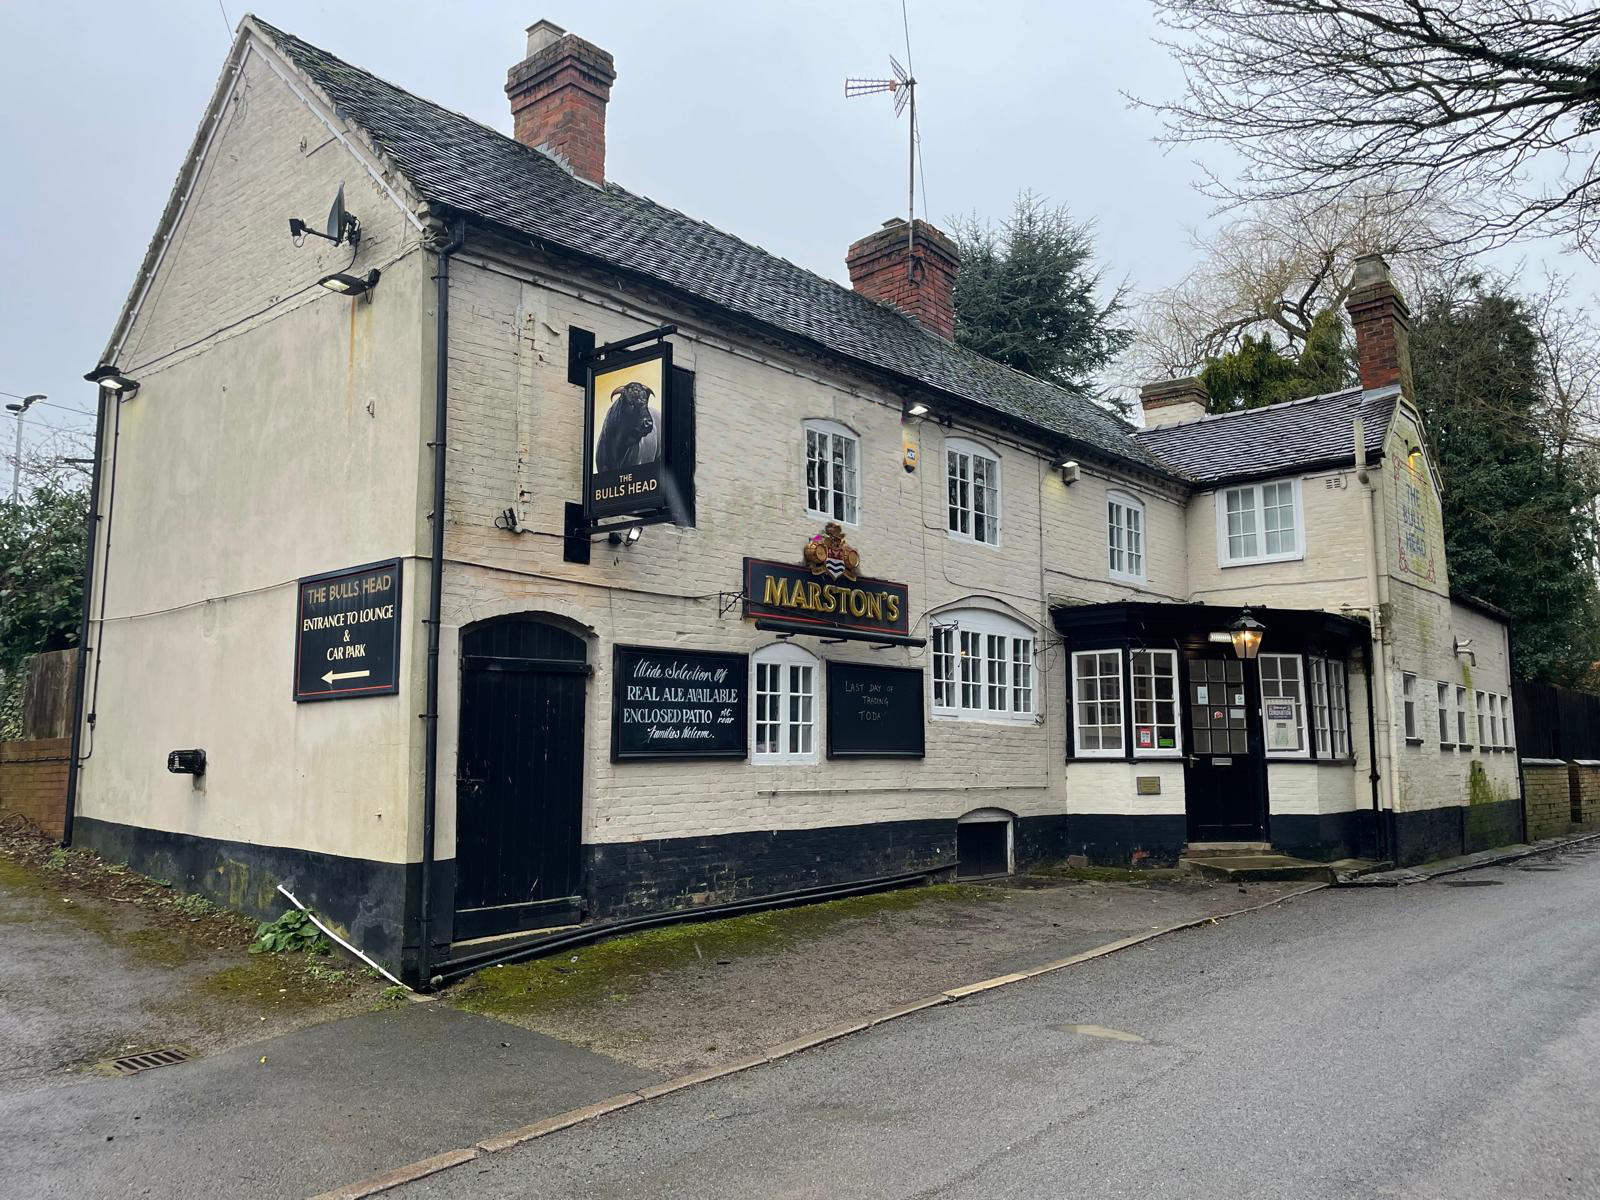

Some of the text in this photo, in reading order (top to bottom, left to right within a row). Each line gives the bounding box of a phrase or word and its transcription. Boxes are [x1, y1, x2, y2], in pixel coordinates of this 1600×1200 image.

[619, 473, 633, 483] THE
[595, 478, 657, 501] BULLS HEAD
[1406, 484, 1420, 506] THE
[1402, 504, 1425, 533] BULLS
[1405, 530, 1426, 557] HEAD
[308, 574, 391, 605] THE BULLS HEAD
[763, 575, 900, 622] MARSTON'S
[303, 604, 394, 632] ENTRANCE TO LOUNGE
[343, 629, 351, 642] &
[327, 643, 366, 661] CAR PARK
[633, 658, 662, 679] Wide
[665, 660, 712, 682] Selection
[627, 685, 738, 703] REAL ALE AVAILABLE
[845, 680, 864, 692] LAST
[868, 683, 881, 692] DAY
[862, 696, 889, 707] TRADING
[623, 708, 713, 724] ENCLOSED PATIO
[647, 725, 680, 743] Families
